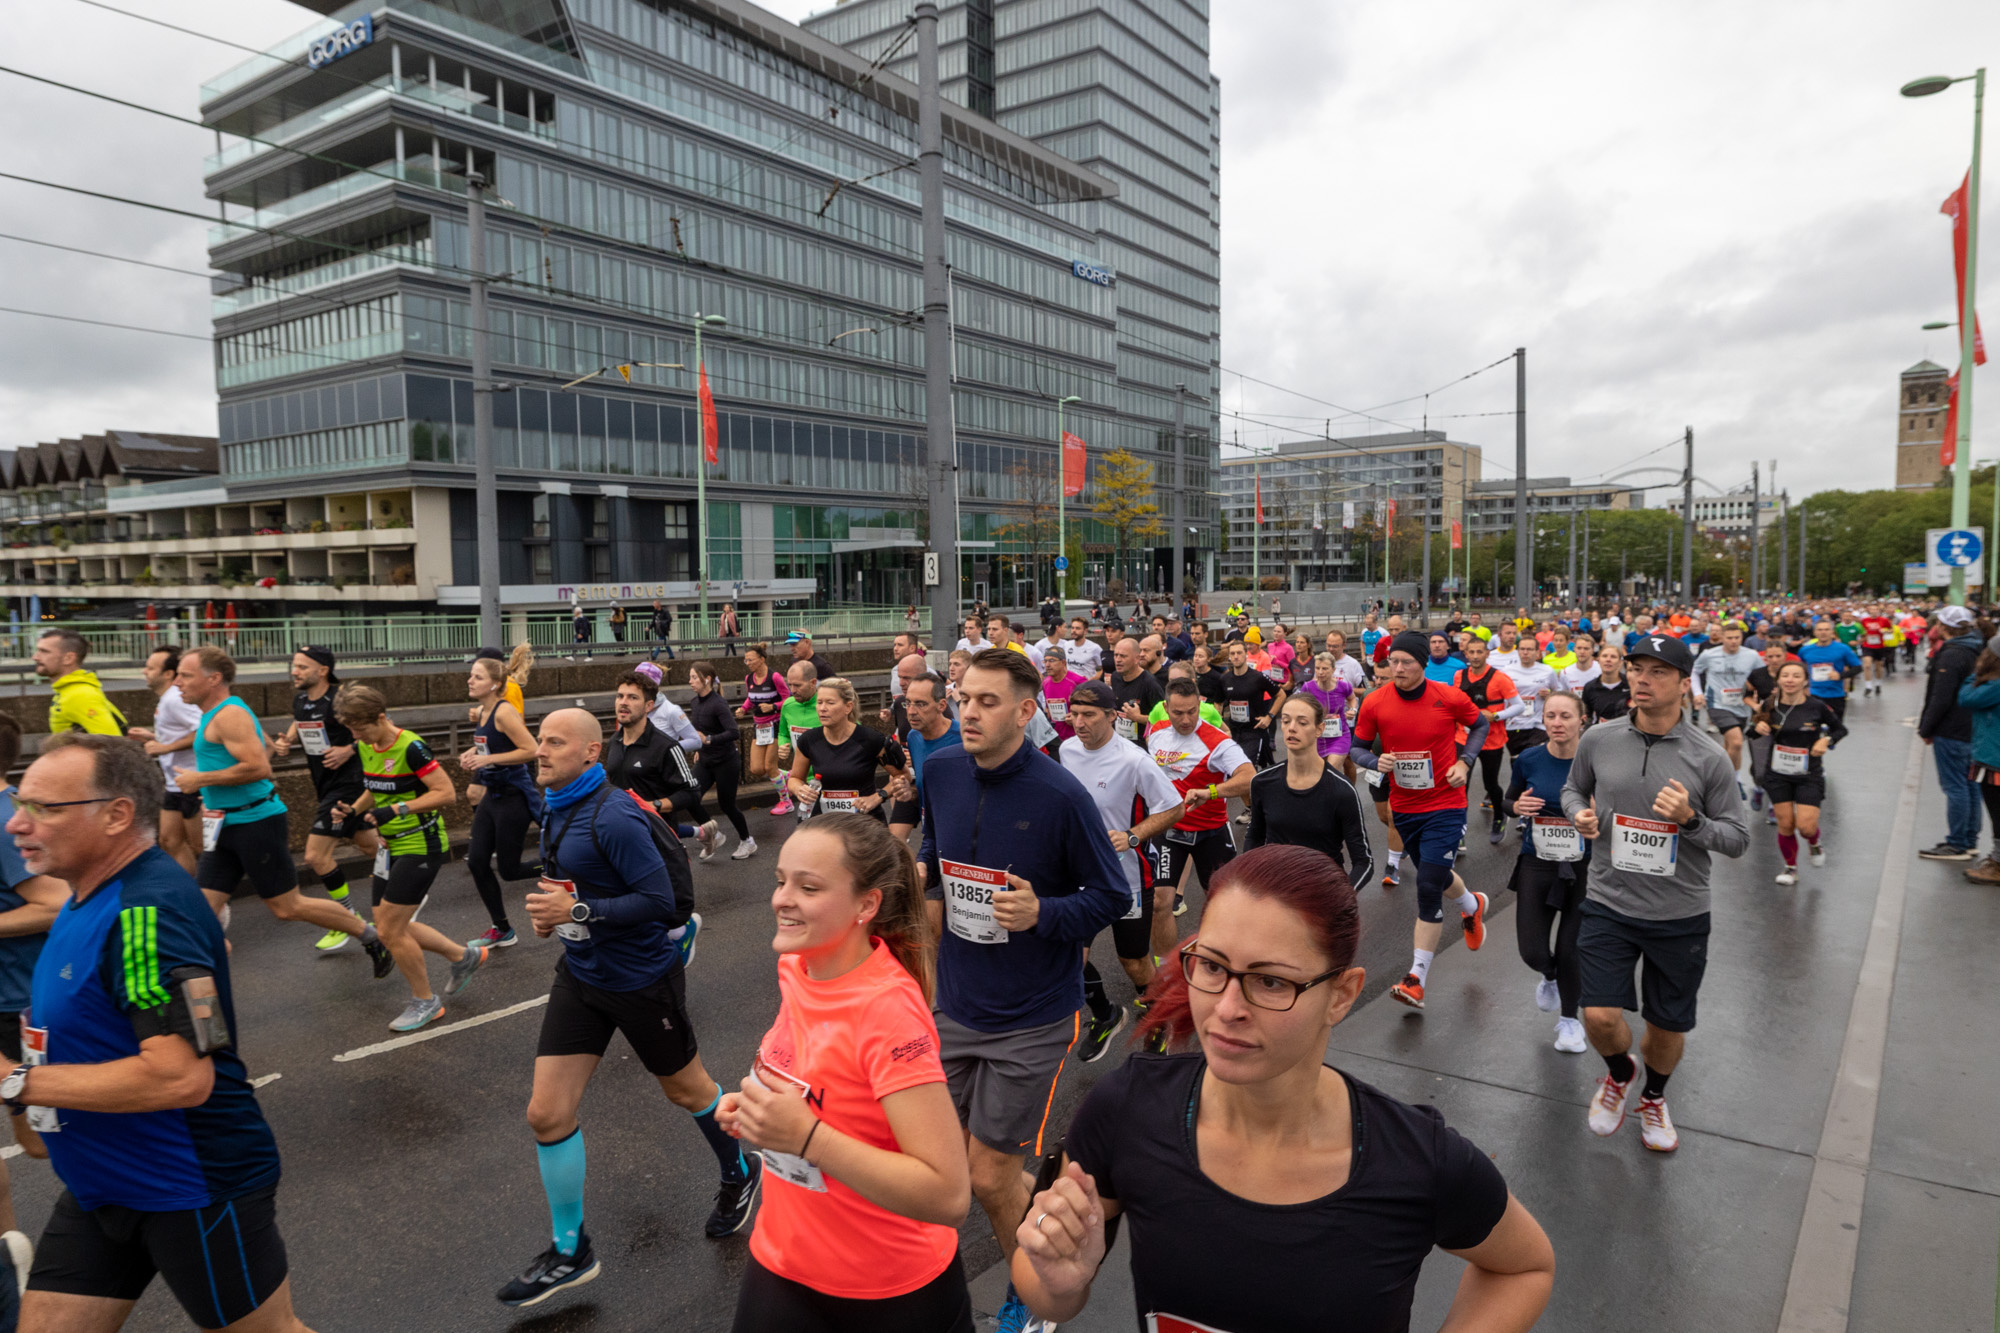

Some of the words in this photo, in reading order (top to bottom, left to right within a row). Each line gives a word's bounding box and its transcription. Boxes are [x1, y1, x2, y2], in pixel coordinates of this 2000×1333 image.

[927, 556, 936, 581] 3
[557, 584, 665, 600] mamonova
[1395, 761, 1425, 770] 12527
[825, 800, 852, 810] 19463
[1541, 827, 1576, 839] 13005
[1622, 830, 1668, 848] 13007
[1631, 849, 1654, 859] Sven
[949, 881, 994, 905] 13852
[952, 904, 991, 922] Benjamin
